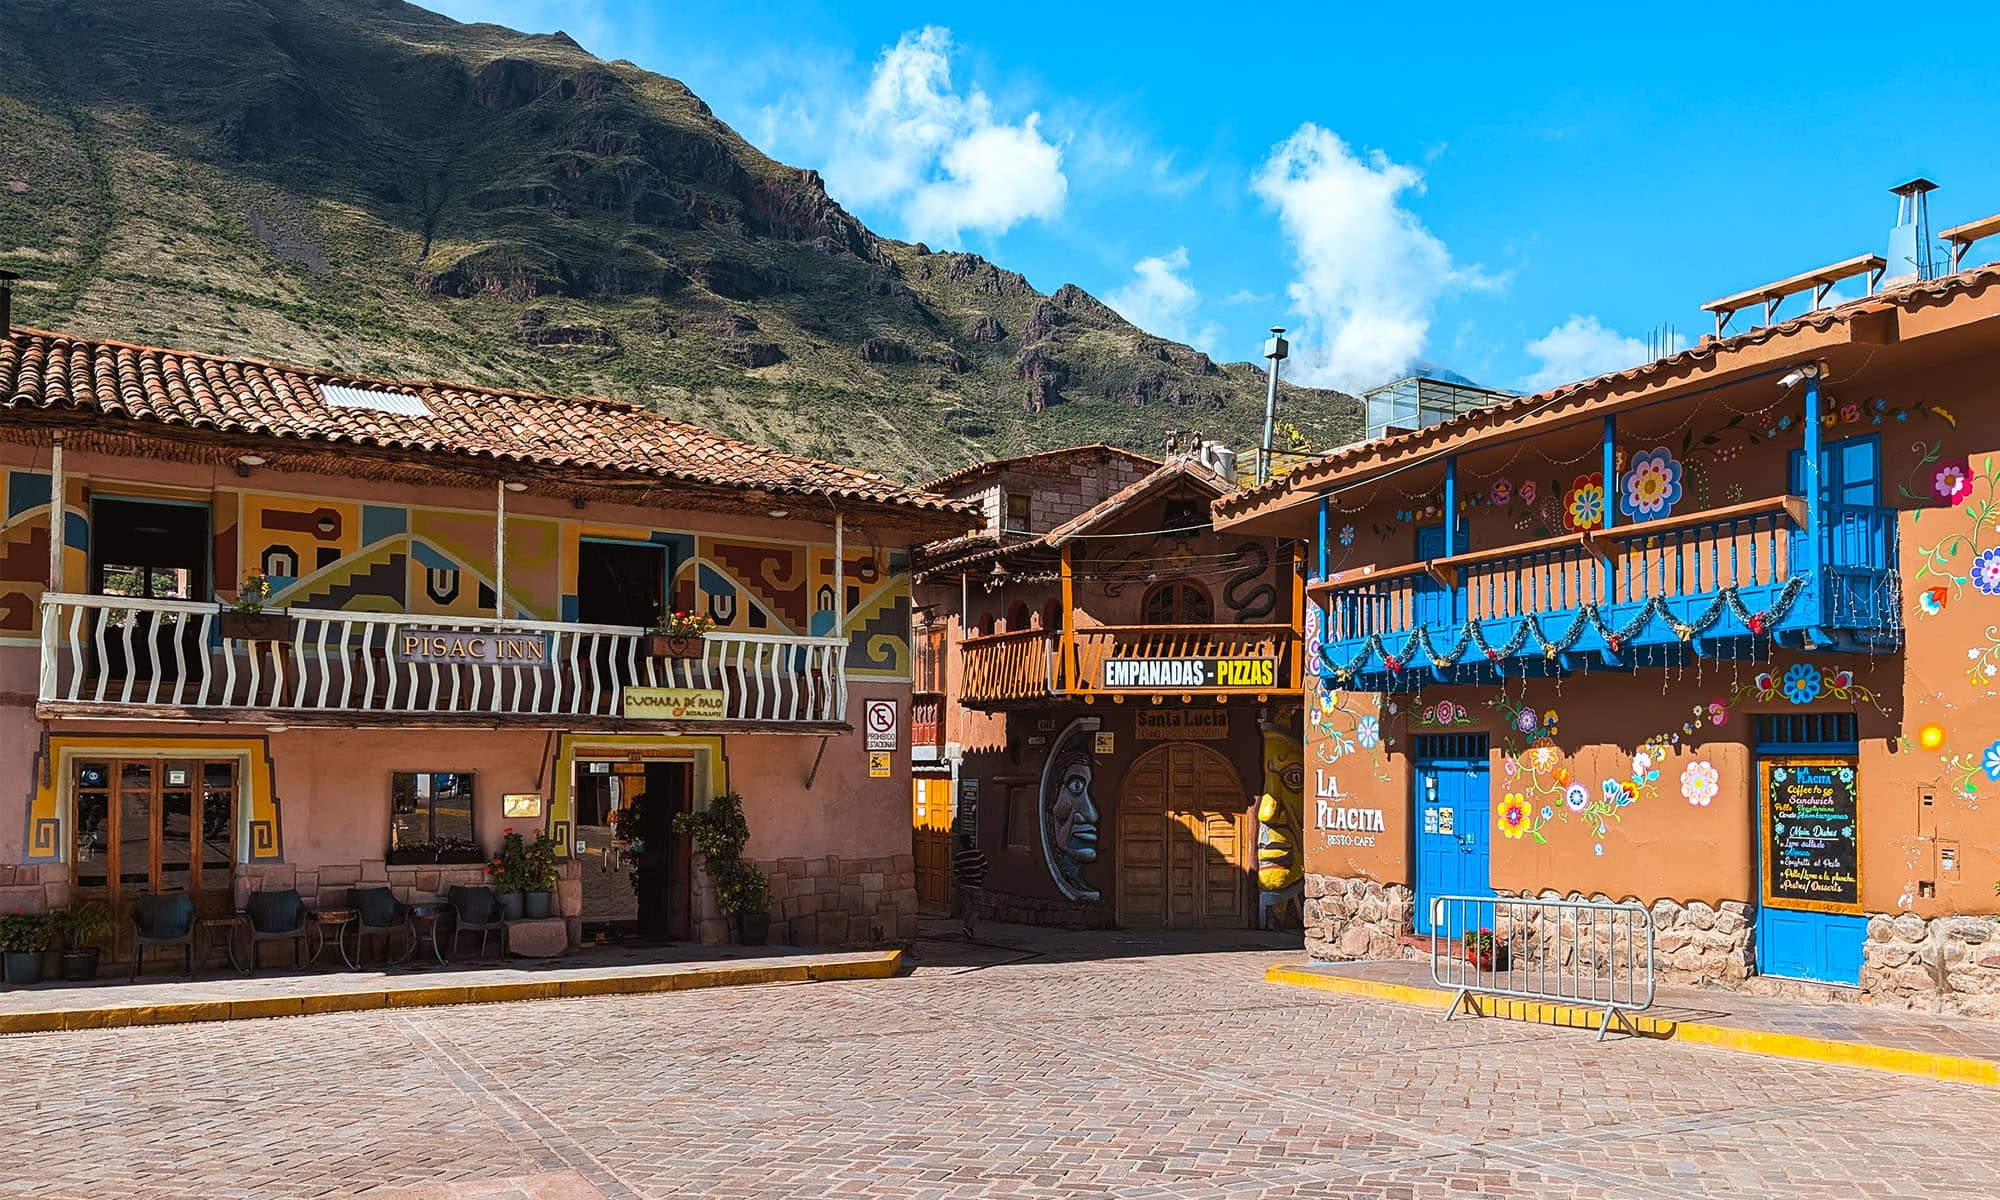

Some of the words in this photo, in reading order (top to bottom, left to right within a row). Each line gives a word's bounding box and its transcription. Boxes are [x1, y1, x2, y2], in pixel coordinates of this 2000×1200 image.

[404, 635, 486, 658] PISAC
[496, 638, 545, 659] INN
[1105, 660, 1204, 686] EMPANADAS
[1217, 660, 1273, 685] PIZZAS
[626, 695, 680, 707] CUCHARA
[699, 698, 722, 709] PALO
[1138, 711, 1181, 727] Santa
[1797, 767, 1809, 775] LA
[1316, 768, 1338, 797] LA
[1797, 774, 1832, 784] PLACITA
[1787, 785, 1812, 796] Coffee
[1813, 785, 1822, 794] to
[1823, 788, 1834, 797] go
[1788, 795, 1834, 805] Sandwich
[1315, 799, 1385, 832] PLACITA
[1789, 825, 1811, 836] Main
[1812, 825, 1837, 837] Dishes
